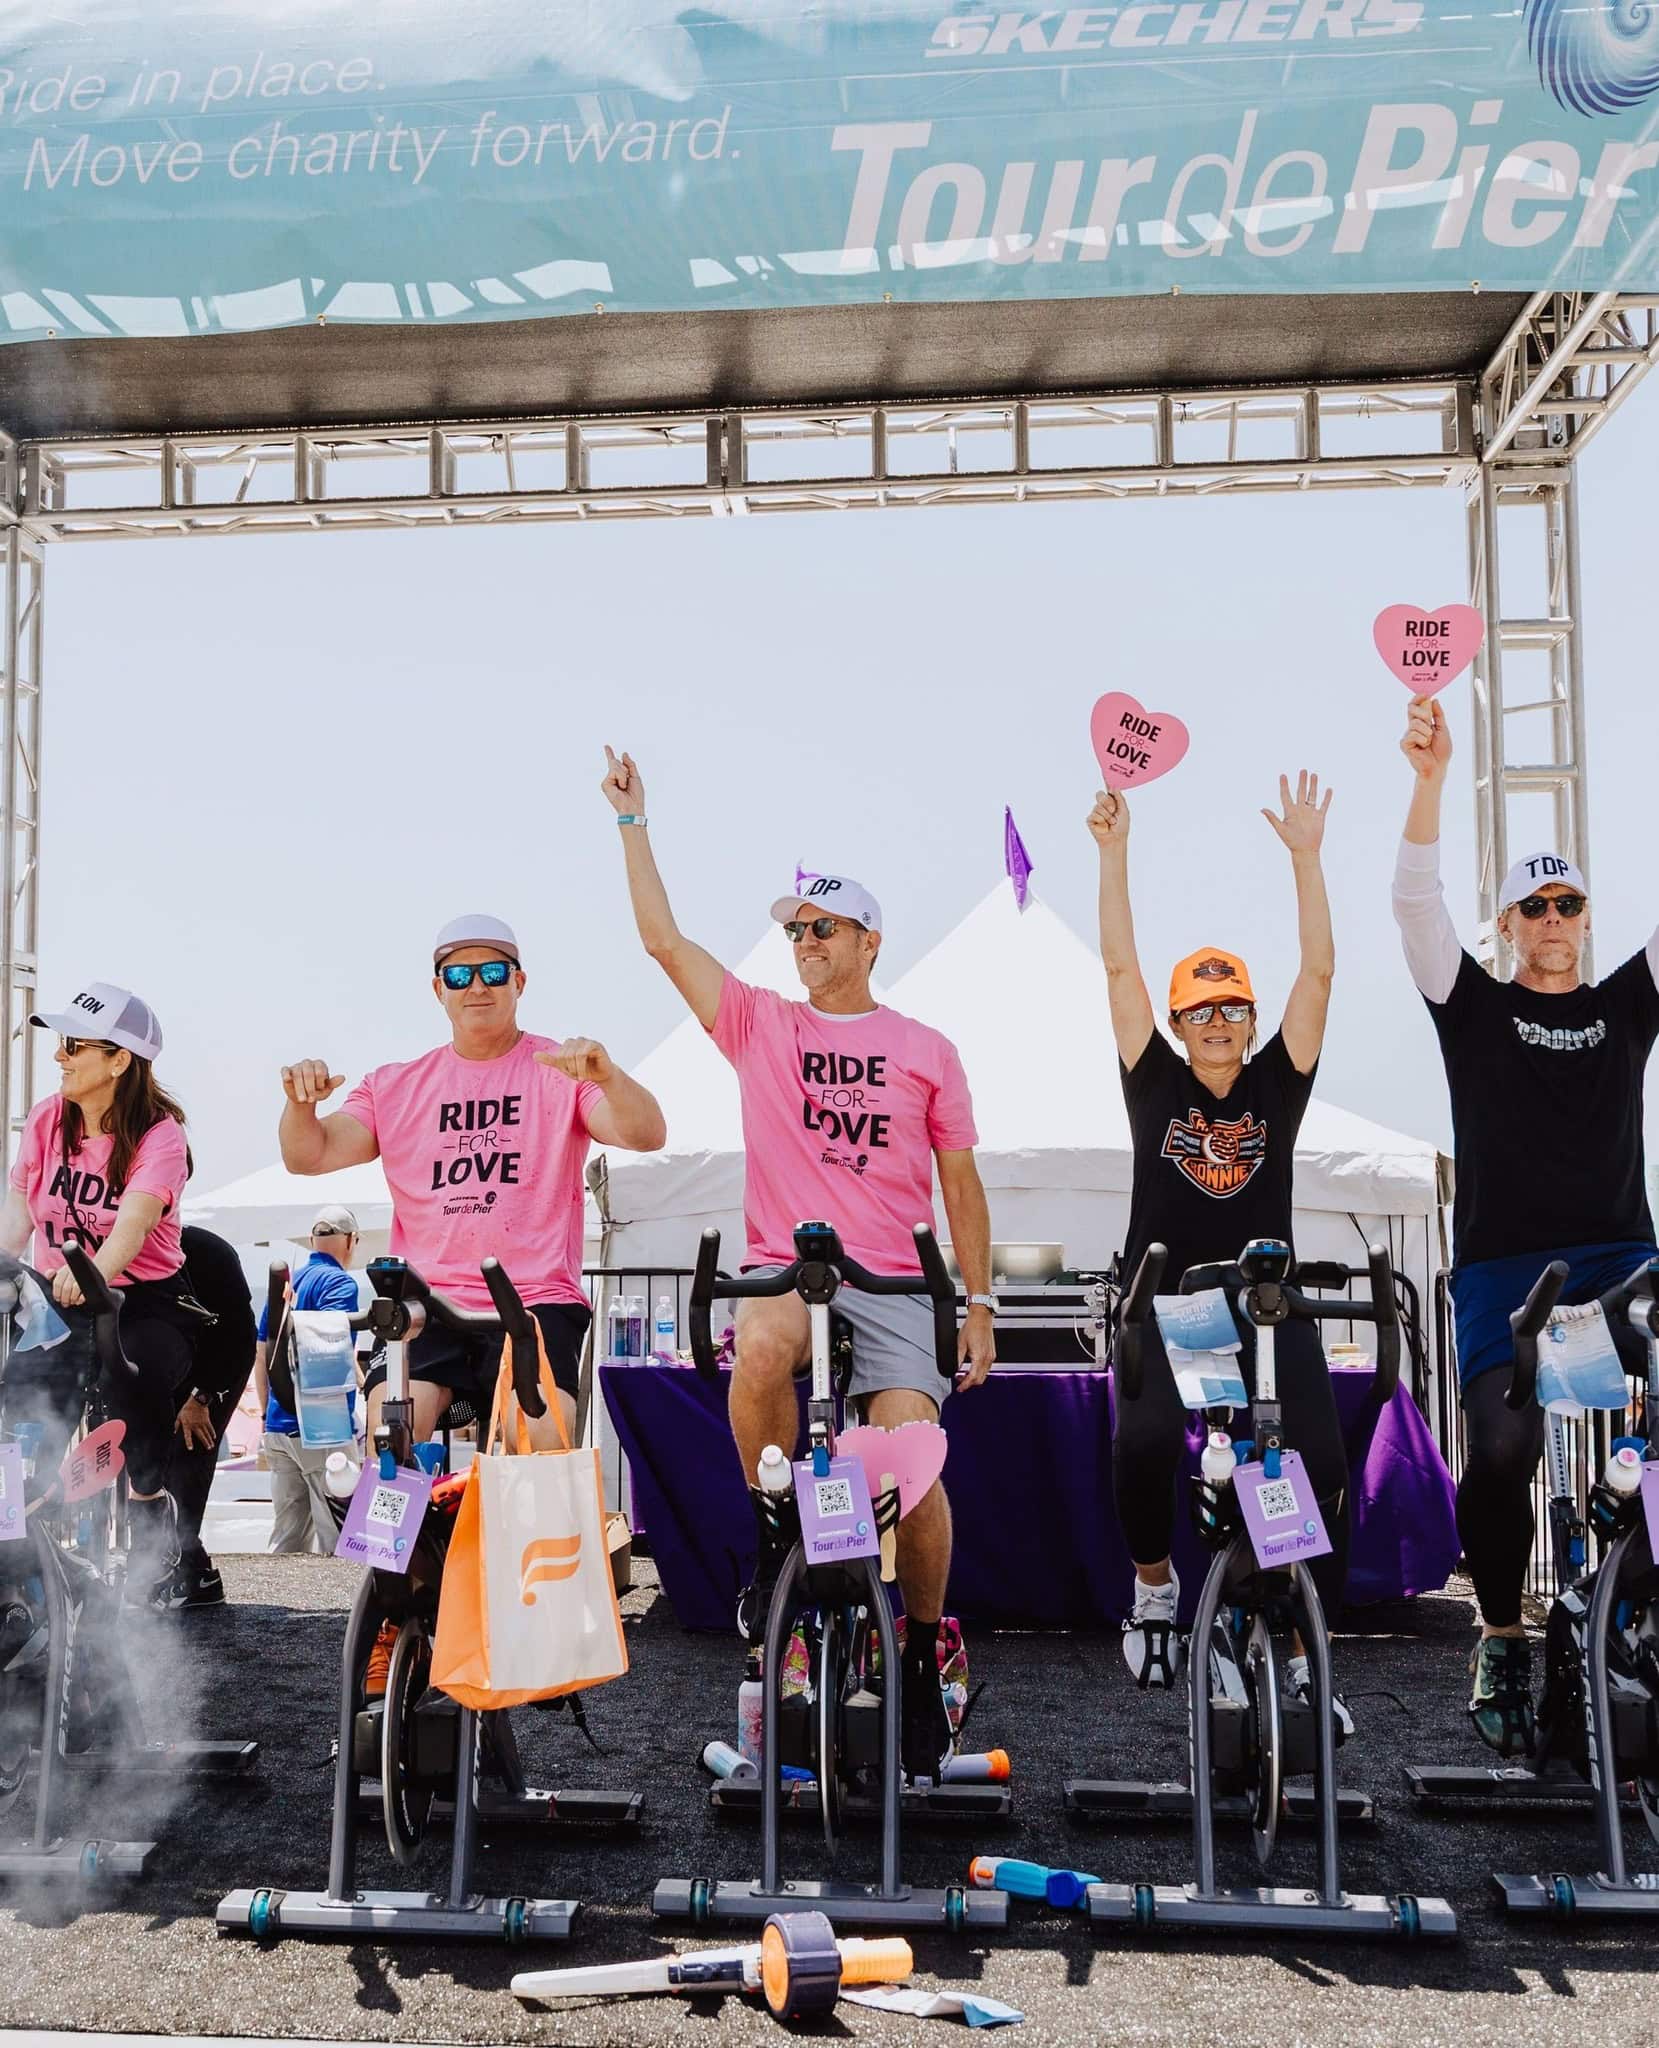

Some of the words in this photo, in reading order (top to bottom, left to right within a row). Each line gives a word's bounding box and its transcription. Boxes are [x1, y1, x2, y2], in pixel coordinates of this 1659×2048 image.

[924, 0, 1424, 58] SKECHERS
[128, 59, 180, 107] in
[201, 52, 387, 112] place.
[24, 133, 201, 191] Move
[228, 115, 447, 185] charity
[469, 106, 741, 167] forward.
[1405, 620, 1451, 637] RIDE
[1415, 638, 1439, 649] FOR
[1402, 650, 1451, 667] LOVE
[1119, 711, 1162, 743] RIDE
[1123, 732, 1146, 749] FOR
[1106, 737, 1152, 770] LOVE
[1525, 856, 1569, 879] TDP
[803, 878, 842, 897] DP
[802, 1051, 887, 1088] RIDE
[438, 1095, 522, 1133] RIDE
[820, 1089, 867, 1109] FOR
[802, 1099, 891, 1149] LOVE
[458, 1129, 500, 1154] FOR
[431, 1151, 521, 1191] LOVE
[95, 1440, 112, 1473] RIDE
